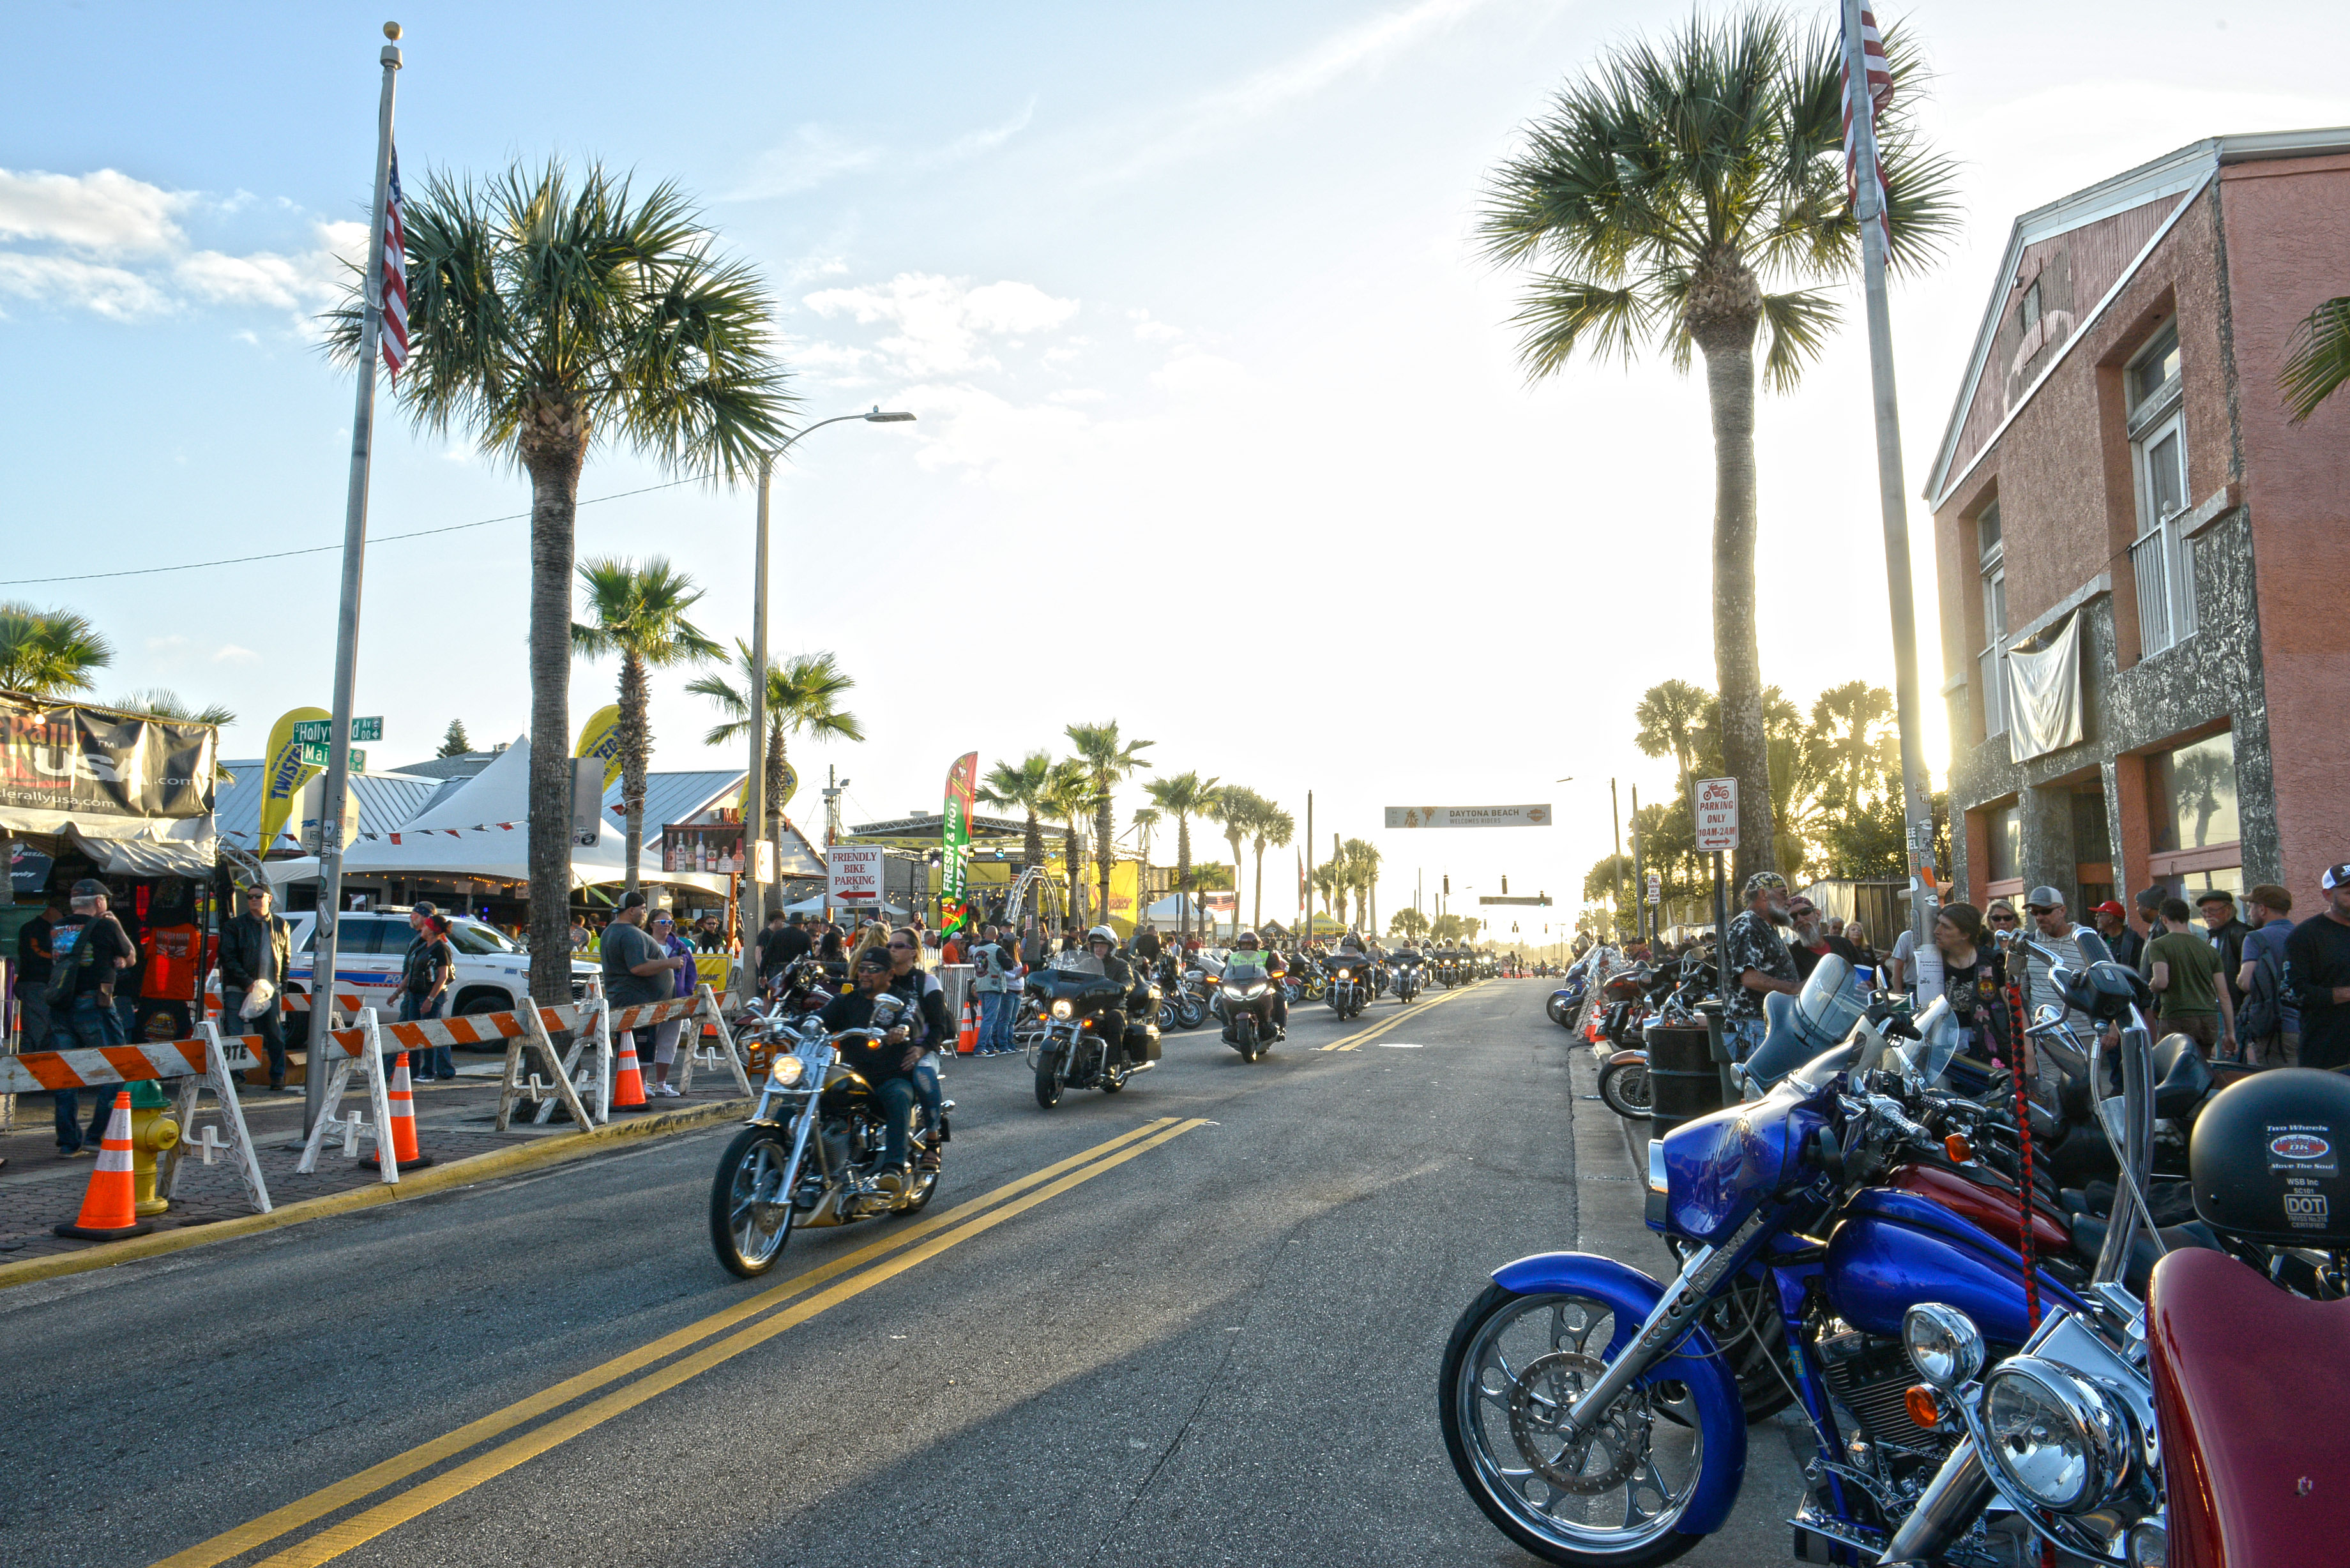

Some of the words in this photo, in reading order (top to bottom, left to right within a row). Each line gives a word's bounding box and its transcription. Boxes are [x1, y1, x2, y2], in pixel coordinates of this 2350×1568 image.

[362, 720, 371, 728] Av
[305, 745, 329, 762] Mai
[271, 744, 302, 799] TWISTE
[1700, 801, 1734, 811] PARKING
[948, 799, 957, 829] HOT
[1707, 814, 1726, 824] ONLY
[1699, 826, 1736, 837] 10AM-2AM
[946, 833, 955, 842] &
[833, 852, 877, 862] FRIENDLY
[844, 864, 865, 873] BIKE
[943, 846, 954, 893] FRESH
[835, 876, 875, 885] PARKING
[2288, 1197, 2323, 1214] DOT
